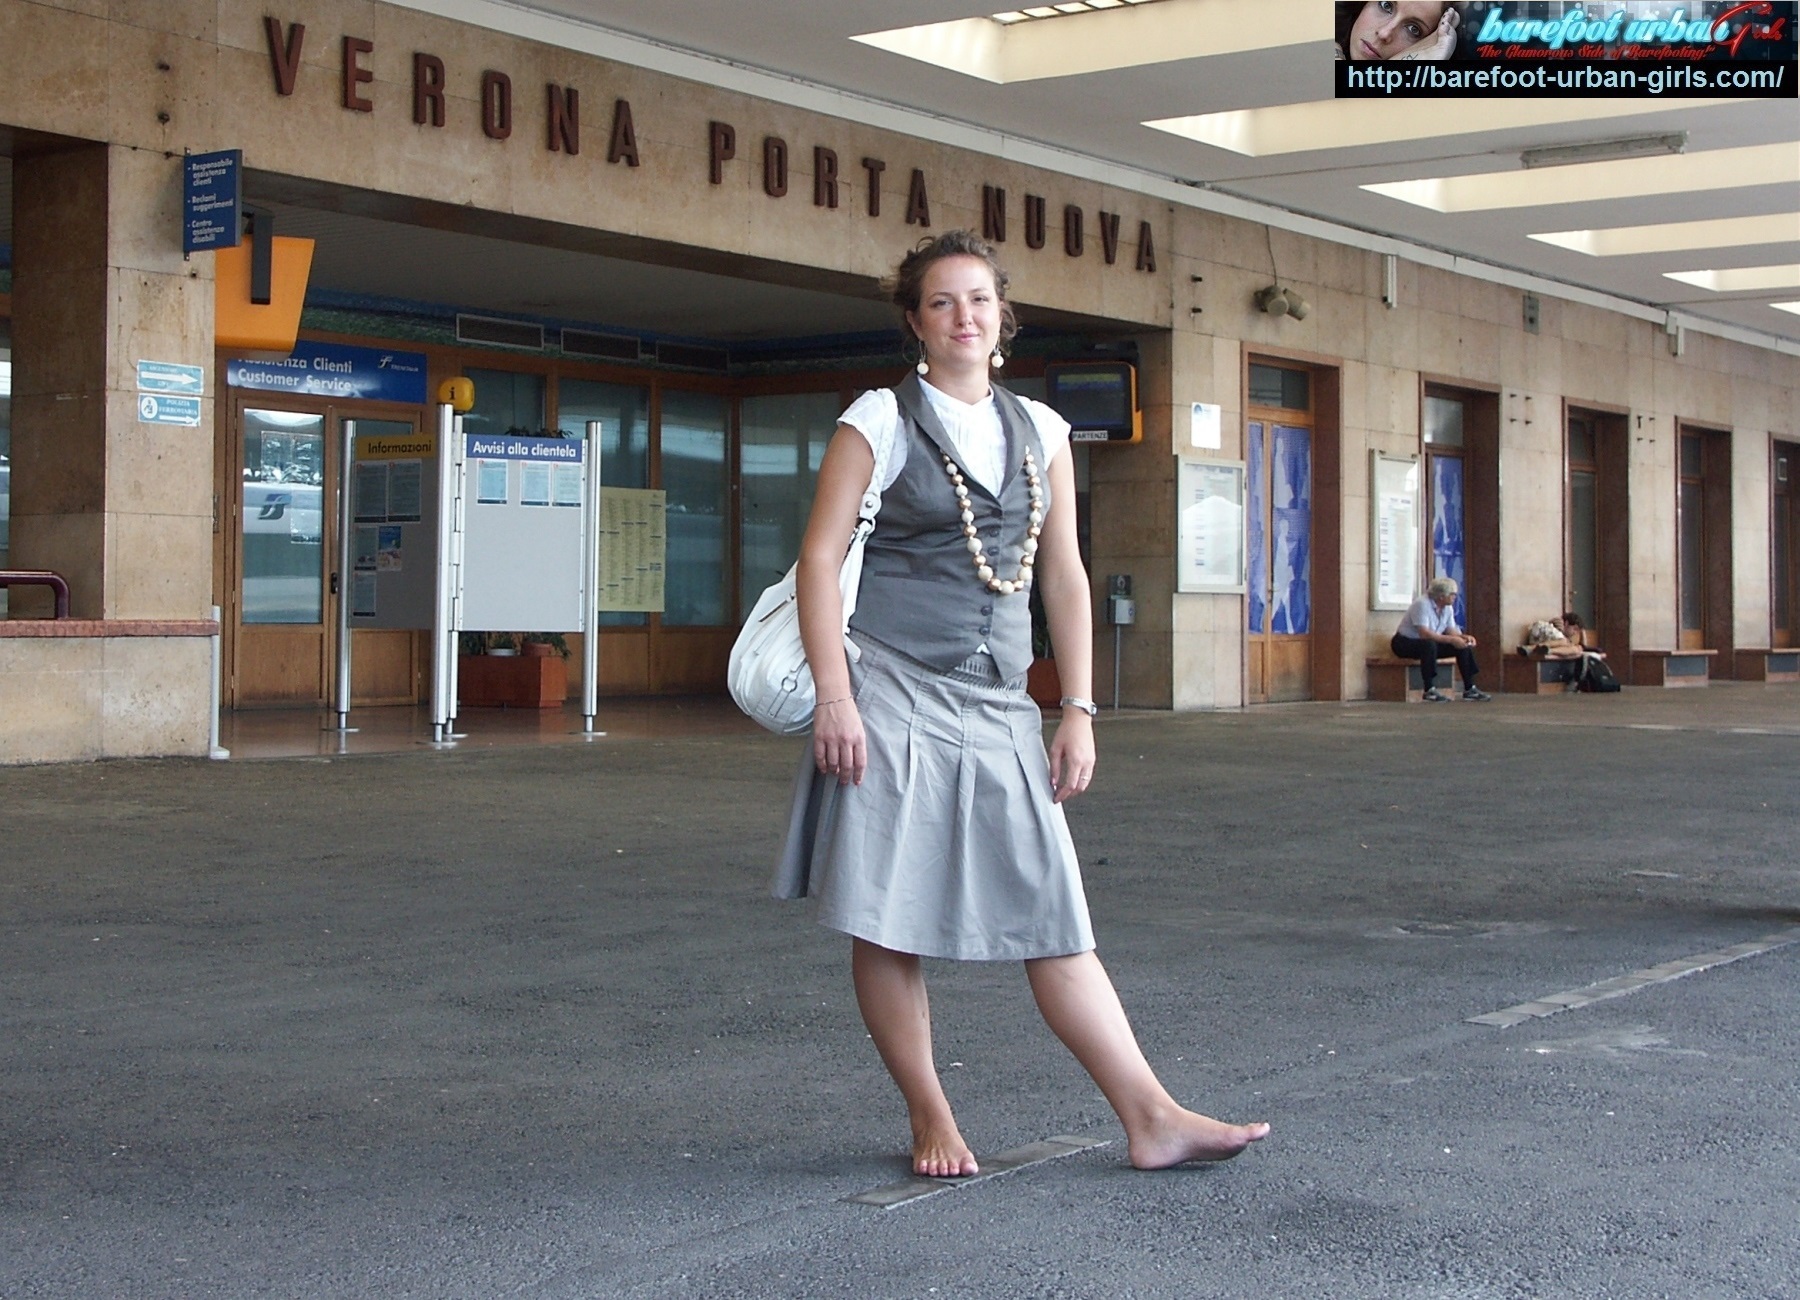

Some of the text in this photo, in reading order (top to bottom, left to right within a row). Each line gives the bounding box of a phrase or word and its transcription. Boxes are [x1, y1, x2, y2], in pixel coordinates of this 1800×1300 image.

[265, 16, 1157, 273] VERONA PORTA NUOVA
[313, 357, 353, 373] Clienti
[238, 368, 352, 391] Customer Service
[367, 439, 432, 454] Informazioni
[473, 440, 576, 458] Avvisi alla clientela
